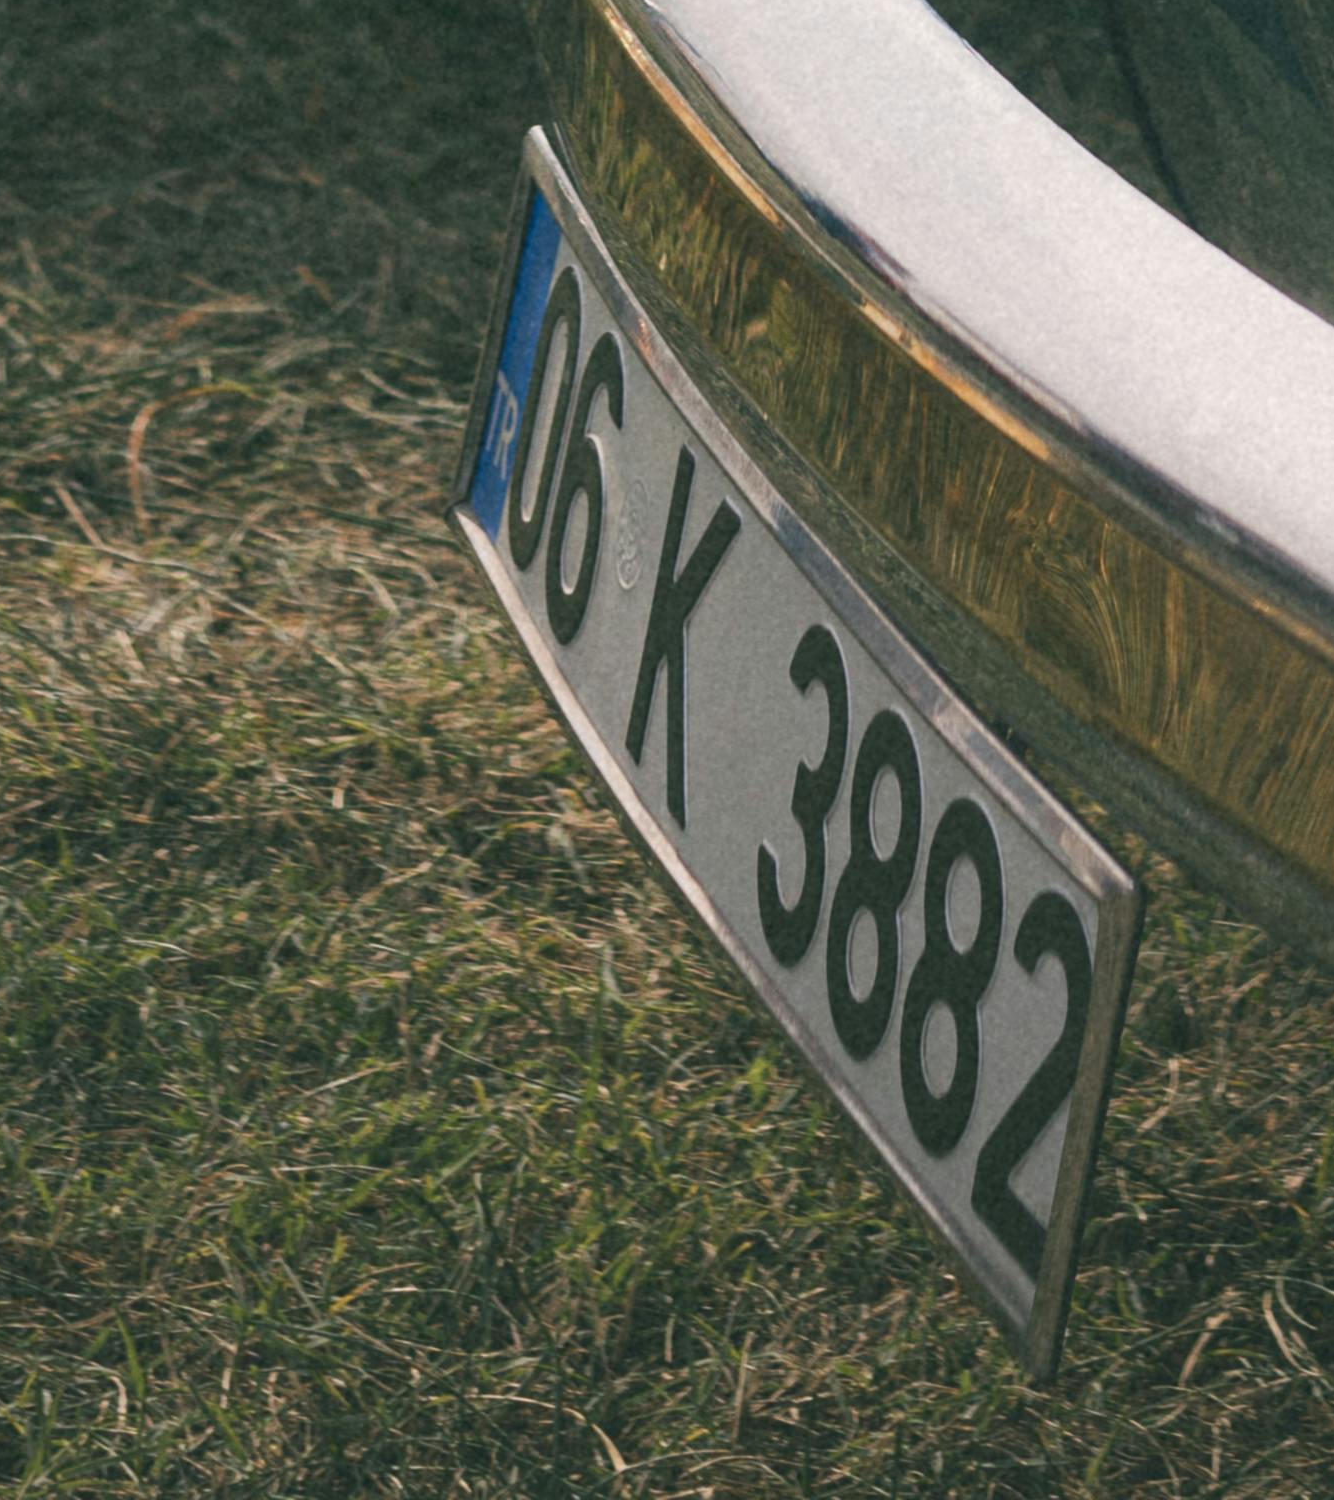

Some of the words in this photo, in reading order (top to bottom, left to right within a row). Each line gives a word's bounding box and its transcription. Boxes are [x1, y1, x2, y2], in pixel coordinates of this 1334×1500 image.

[484, 369, 518, 482] TR
[508, 264, 625, 647] 06
[624, 443, 743, 833] K
[756, 623, 1095, 1288] 3882
